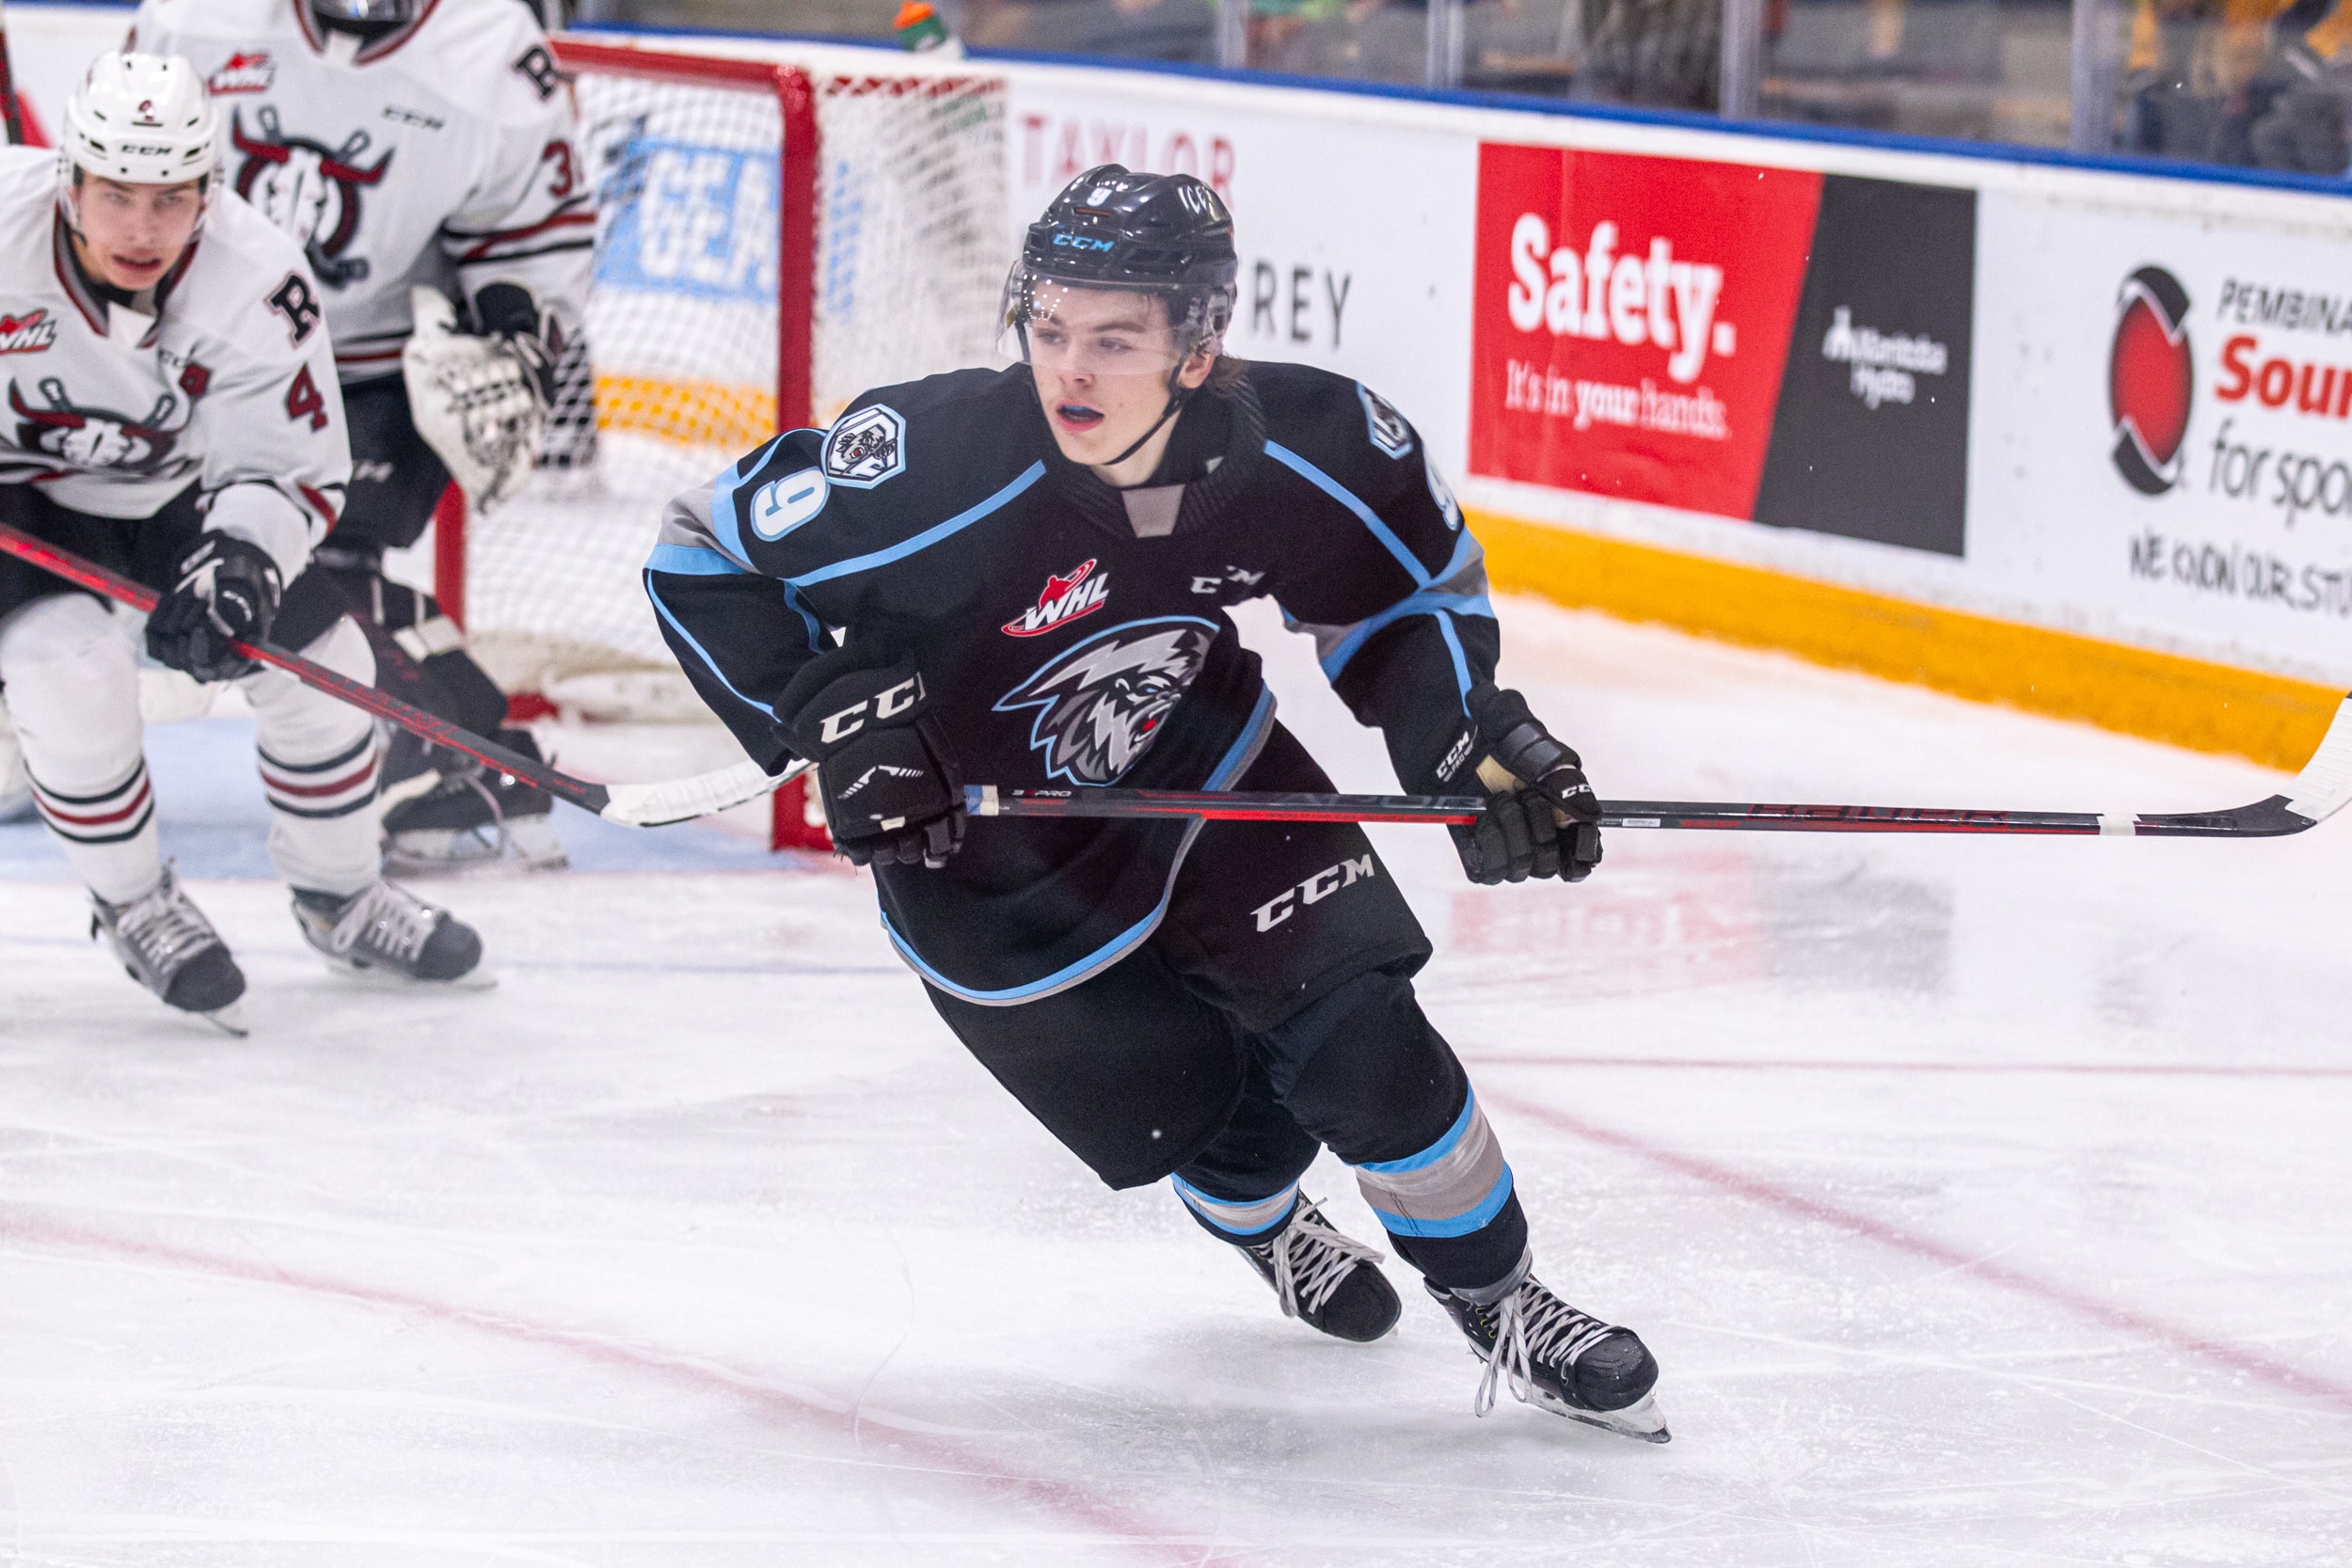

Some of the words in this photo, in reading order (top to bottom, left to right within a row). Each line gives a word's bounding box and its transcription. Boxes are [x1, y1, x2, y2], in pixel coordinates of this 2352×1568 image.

[515, 45, 572, 101] R
[121, 143, 172, 156] CCM
[1053, 232, 1115, 253] CCM
[265, 274, 320, 346] R
[1507, 213, 1737, 383] Safety.
[286, 363, 327, 431] 4
[1573, 379, 1641, 431] your
[2209, 417, 2272, 499] for
[2272, 451, 2352, 531] spo
[1025, 572, 1110, 631] WHL
[1436, 730, 1470, 779] CCM
[1249, 853, 1375, 932] CCM
